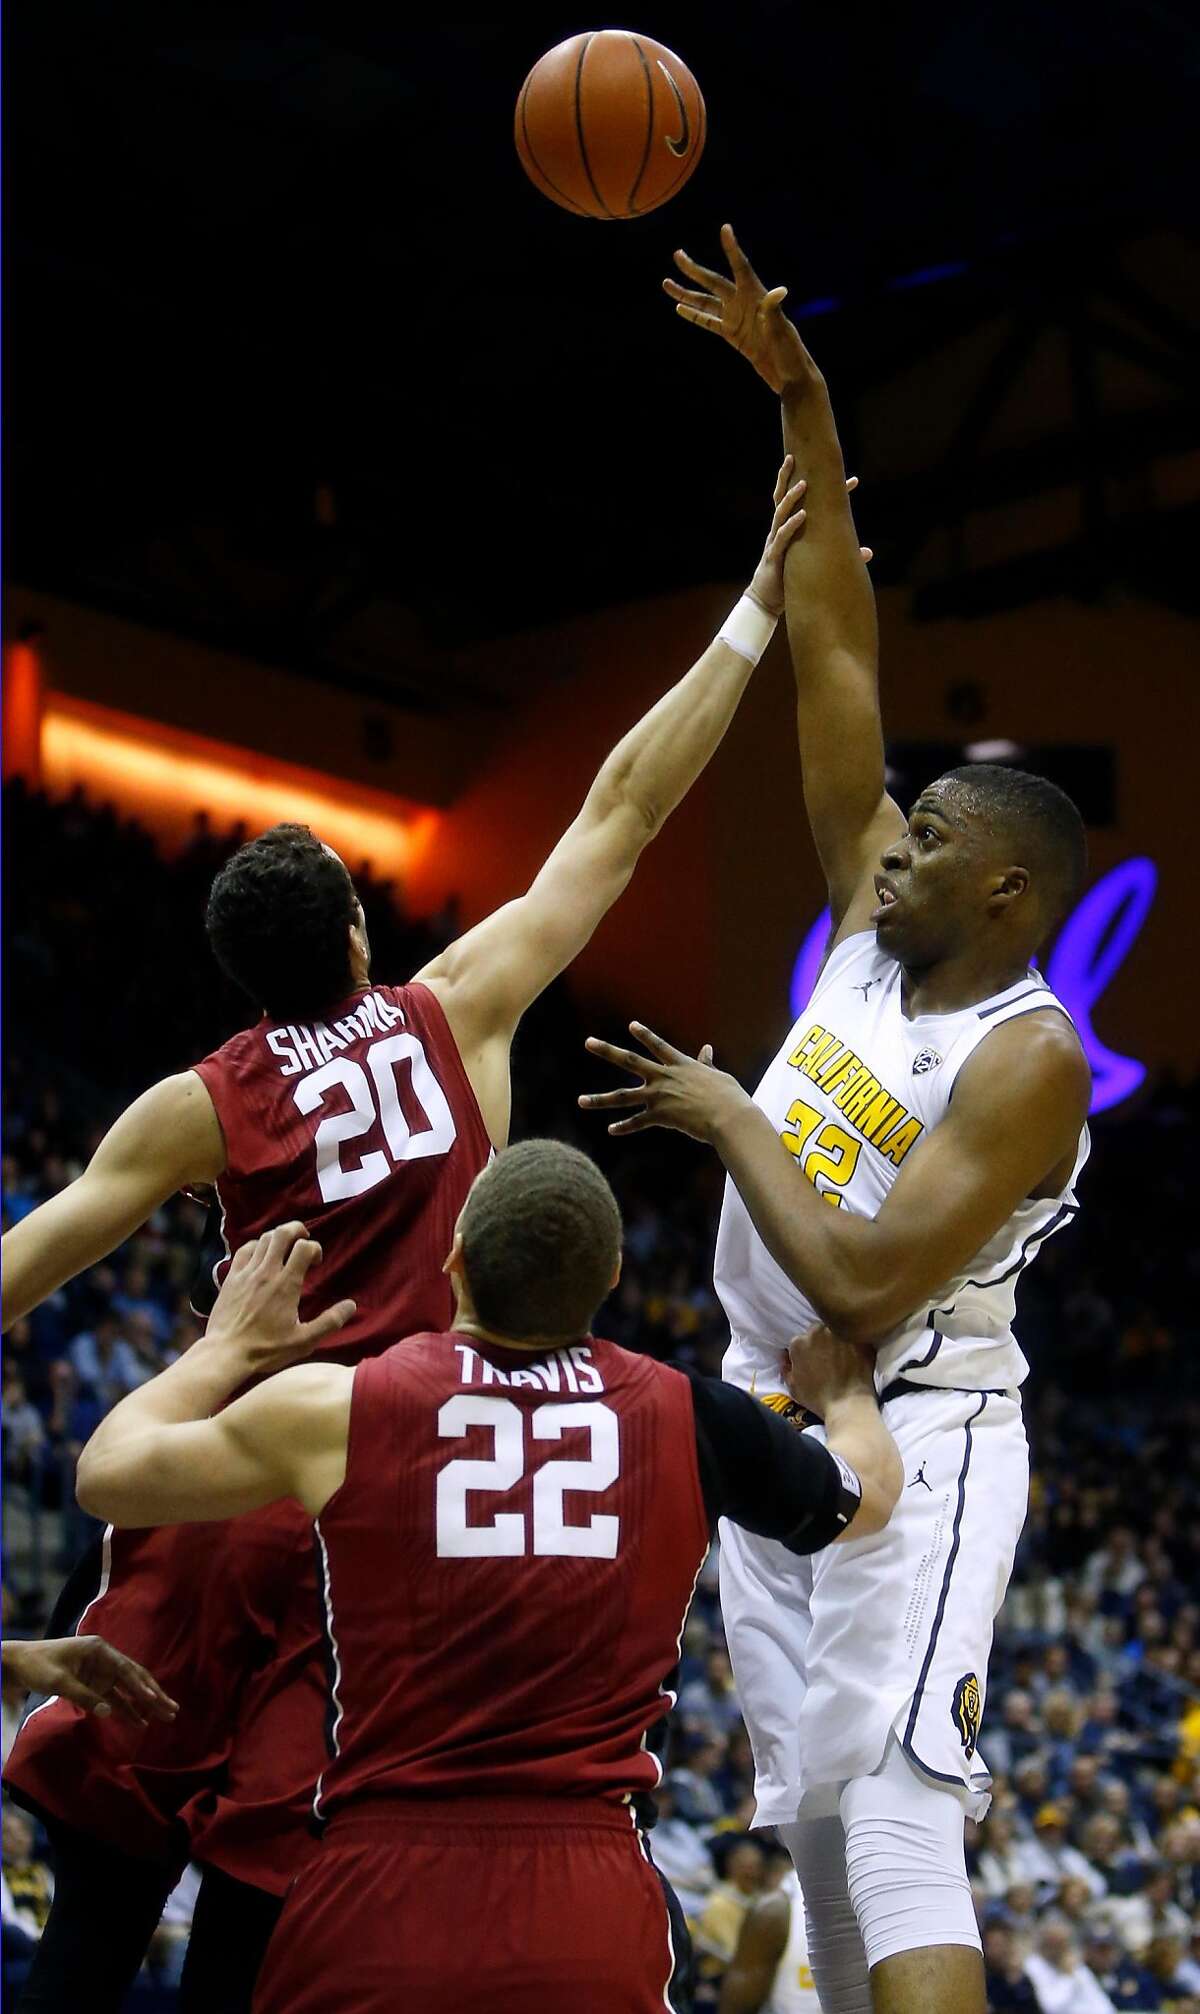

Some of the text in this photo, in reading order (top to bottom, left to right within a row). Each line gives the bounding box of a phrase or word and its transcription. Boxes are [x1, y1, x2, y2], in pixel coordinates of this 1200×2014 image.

[265, 992, 405, 1076] SHARMA
[787, 1024, 924, 1167] CALIFORNIA
[293, 1033, 457, 1203] 20
[455, 1345, 605, 1393] TRAVIS
[436, 1394, 620, 1559] 22
